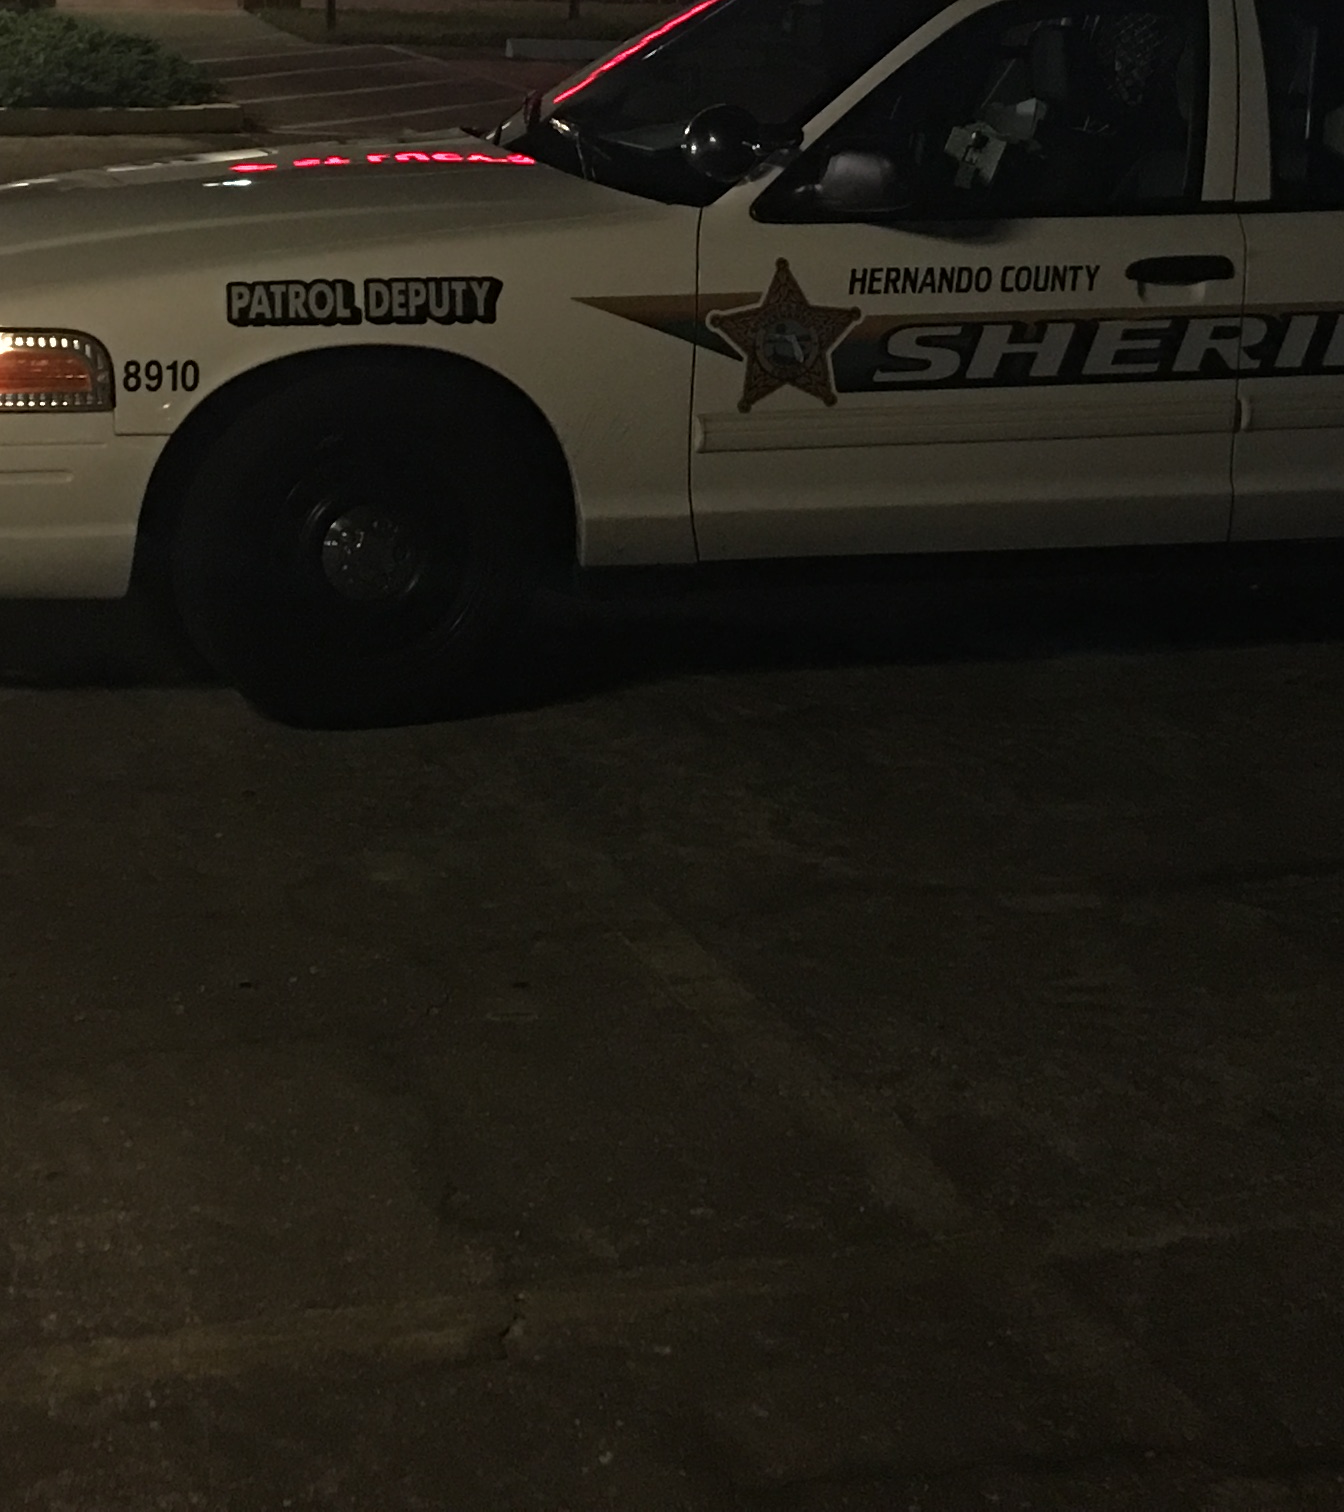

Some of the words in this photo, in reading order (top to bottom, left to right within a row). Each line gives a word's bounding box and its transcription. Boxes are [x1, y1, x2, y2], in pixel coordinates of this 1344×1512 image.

[848, 265, 994, 296] HERNANDO
[999, 264, 1101, 293] COUNTY
[228, 279, 361, 324] PATROL
[365, 276, 503, 324] DEPUTY
[123, 358, 200, 393] 8910
